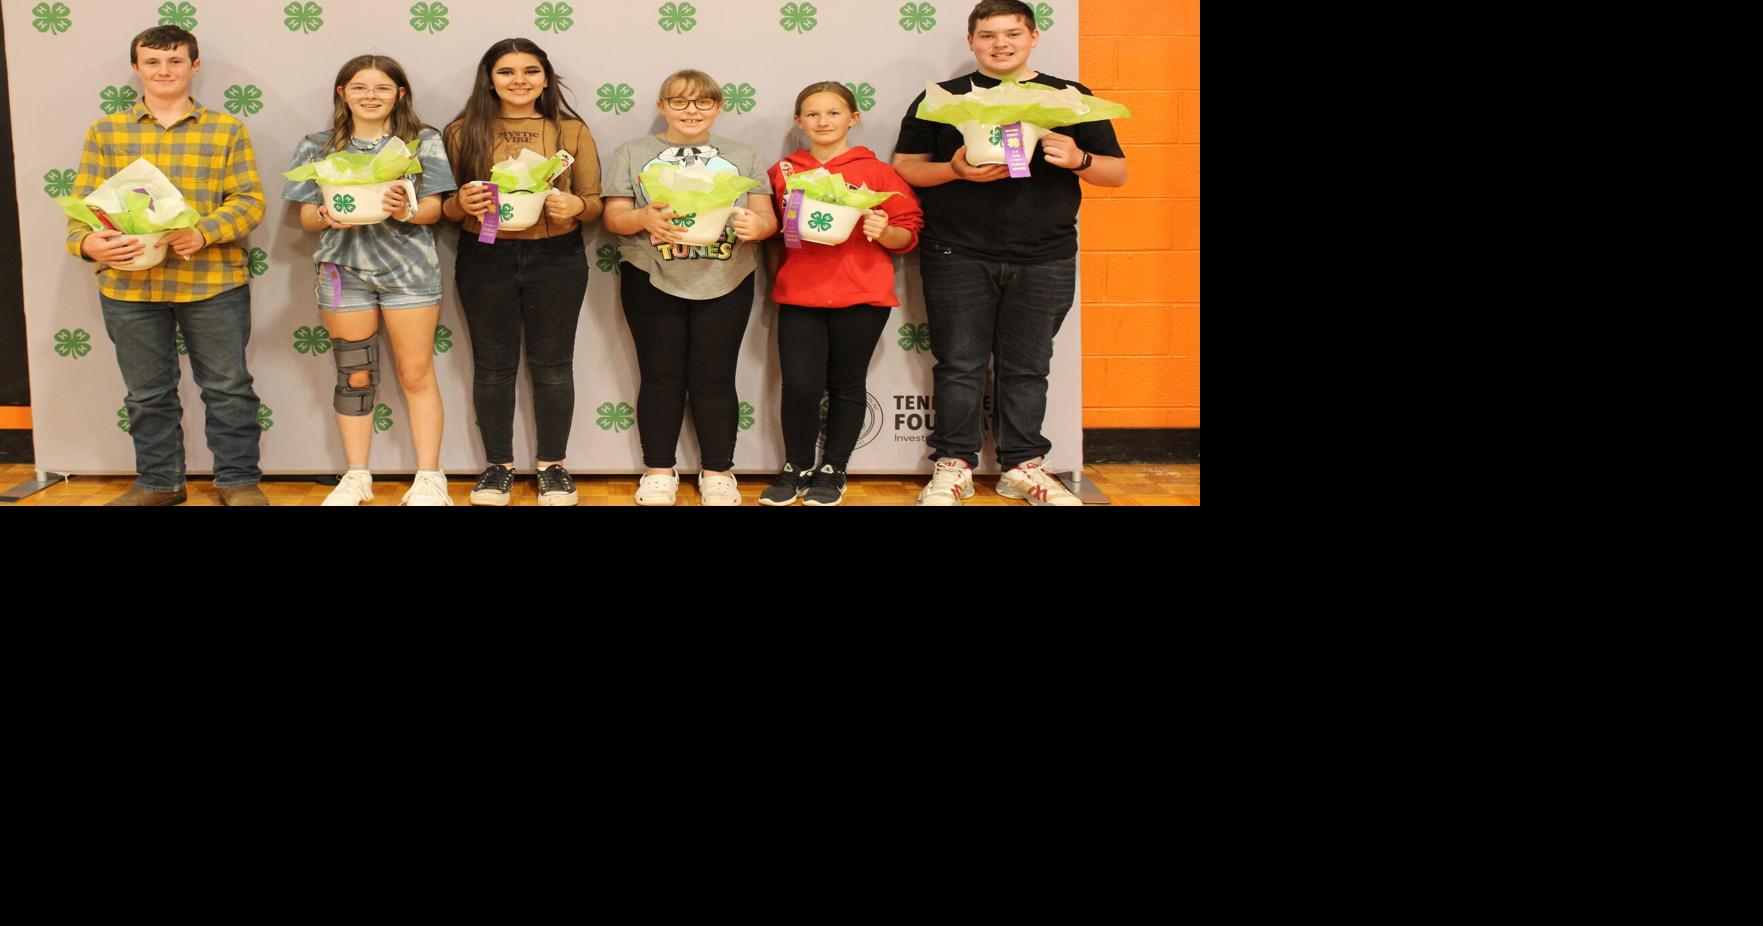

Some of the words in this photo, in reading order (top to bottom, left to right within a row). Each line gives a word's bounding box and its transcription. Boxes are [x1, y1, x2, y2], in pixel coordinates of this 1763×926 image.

[657, 242, 734, 260] TUNES
[894, 413, 937, 431] FOU
[894, 434, 928, 442] Invest
